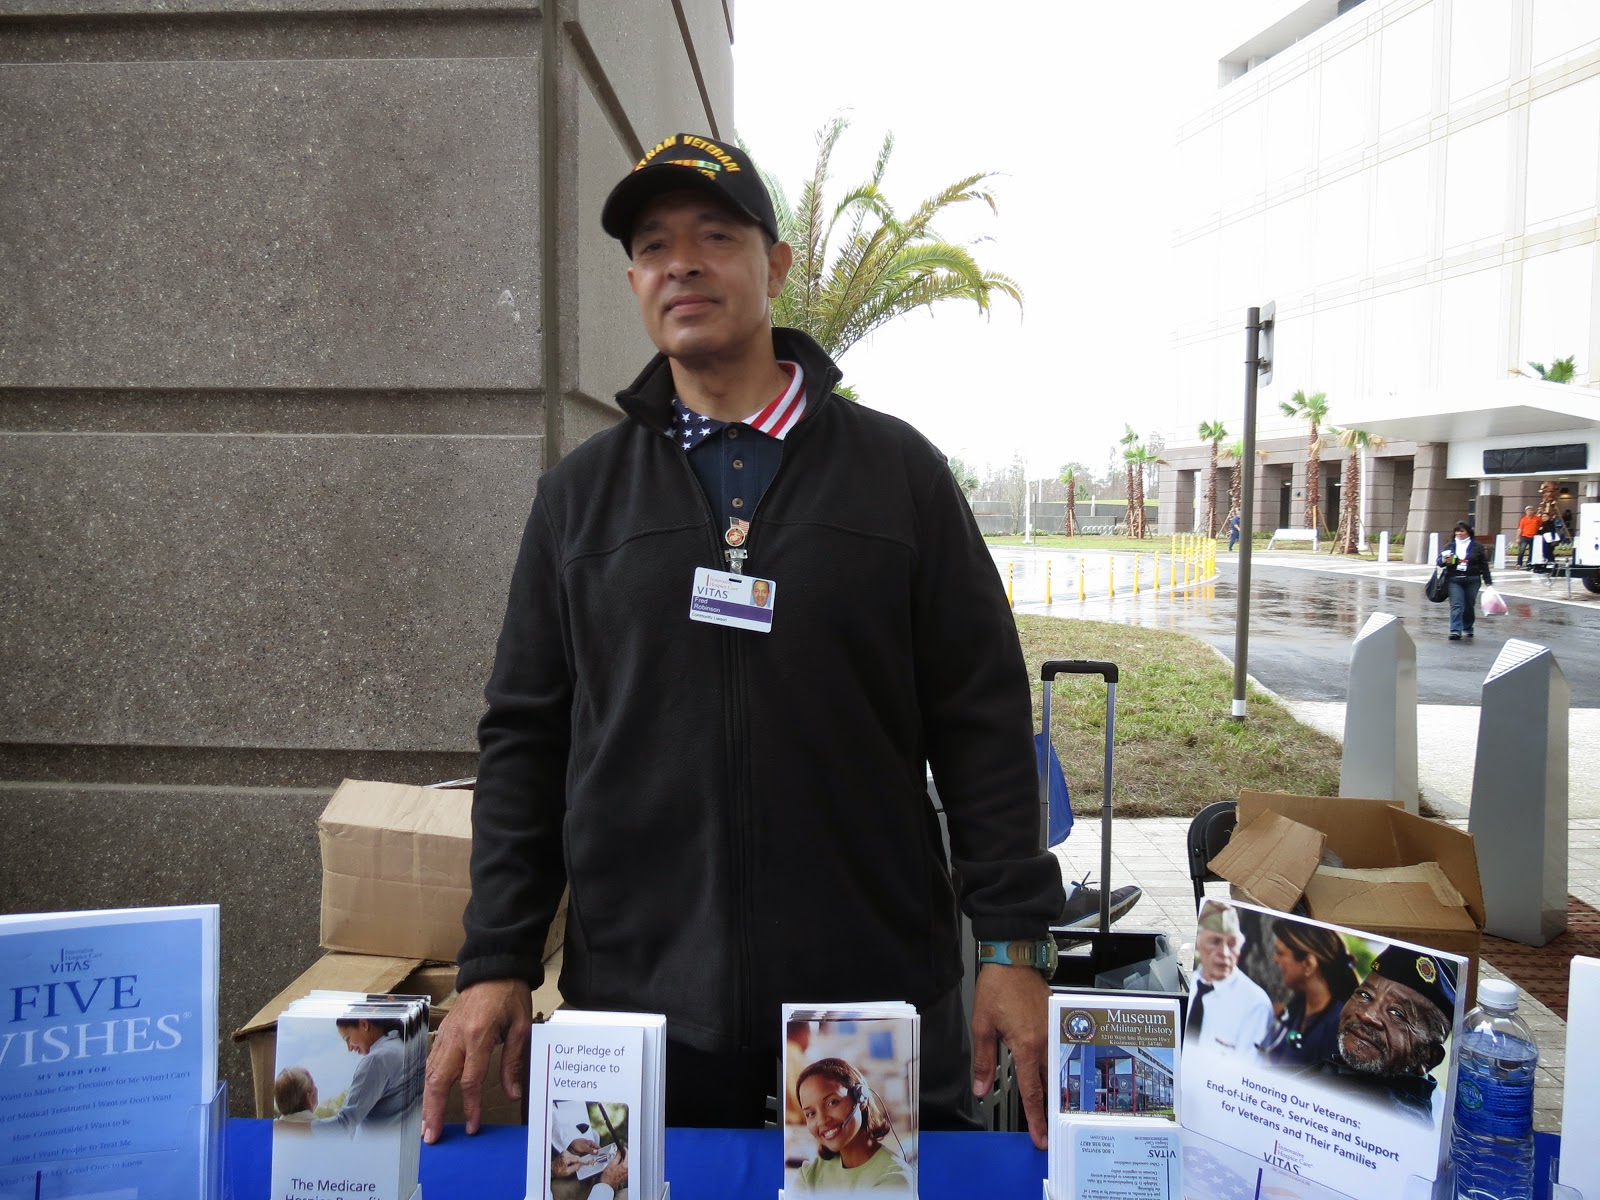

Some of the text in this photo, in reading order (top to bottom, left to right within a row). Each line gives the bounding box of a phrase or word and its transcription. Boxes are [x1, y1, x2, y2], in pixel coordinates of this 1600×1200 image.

[683, 135, 741, 172] VETERAN
[697, 586, 728, 599] VITAS
[694, 603, 720, 613] Robinson
[50, 960, 92, 973] VITAS
[8, 975, 141, 1023] FIVE
[1107, 1009, 1167, 1024] Museum
[1111, 1024, 1142, 1034] Military
[1144, 1025, 1173, 1036] History
[554, 1044, 626, 1058] Our Pledge of
[58, 1069, 84, 1078] WISH
[554, 1060, 620, 1074] Allegiance to
[0, 1092, 21, 1100] Want
[34, 1087, 55, 1096] Make
[77, 1080, 114, 1090] Decisions
[141, 1074, 164, 1082] When
[553, 1078, 597, 1089] Veterans
[18, 1109, 49, 1120] Medical
[51, 1103, 91, 1115] Treatment
[99, 1100, 118, 1108] Want
[130, 1096, 150, 1104] Don't
[1241, 1076, 1361, 1129] Honoring Our Veterans:
[1206, 1080, 1400, 1162] End-of-Life Care, Services and Support
[12, 1134, 31, 1142] How
[34, 1125, 83, 1139] Comfortable
[1221, 1100, 1377, 1170] for Veterans and Their Families
[39, 1150, 59, 1159] Want
[99, 1141, 117, 1150] Treat
[1148, 1150, 1176, 1158] VITAS
[1278, 1149, 1298, 1162] Hospice
[1264, 1152, 1299, 1175] VITAS
[291, 1178, 376, 1191] The Medicare
